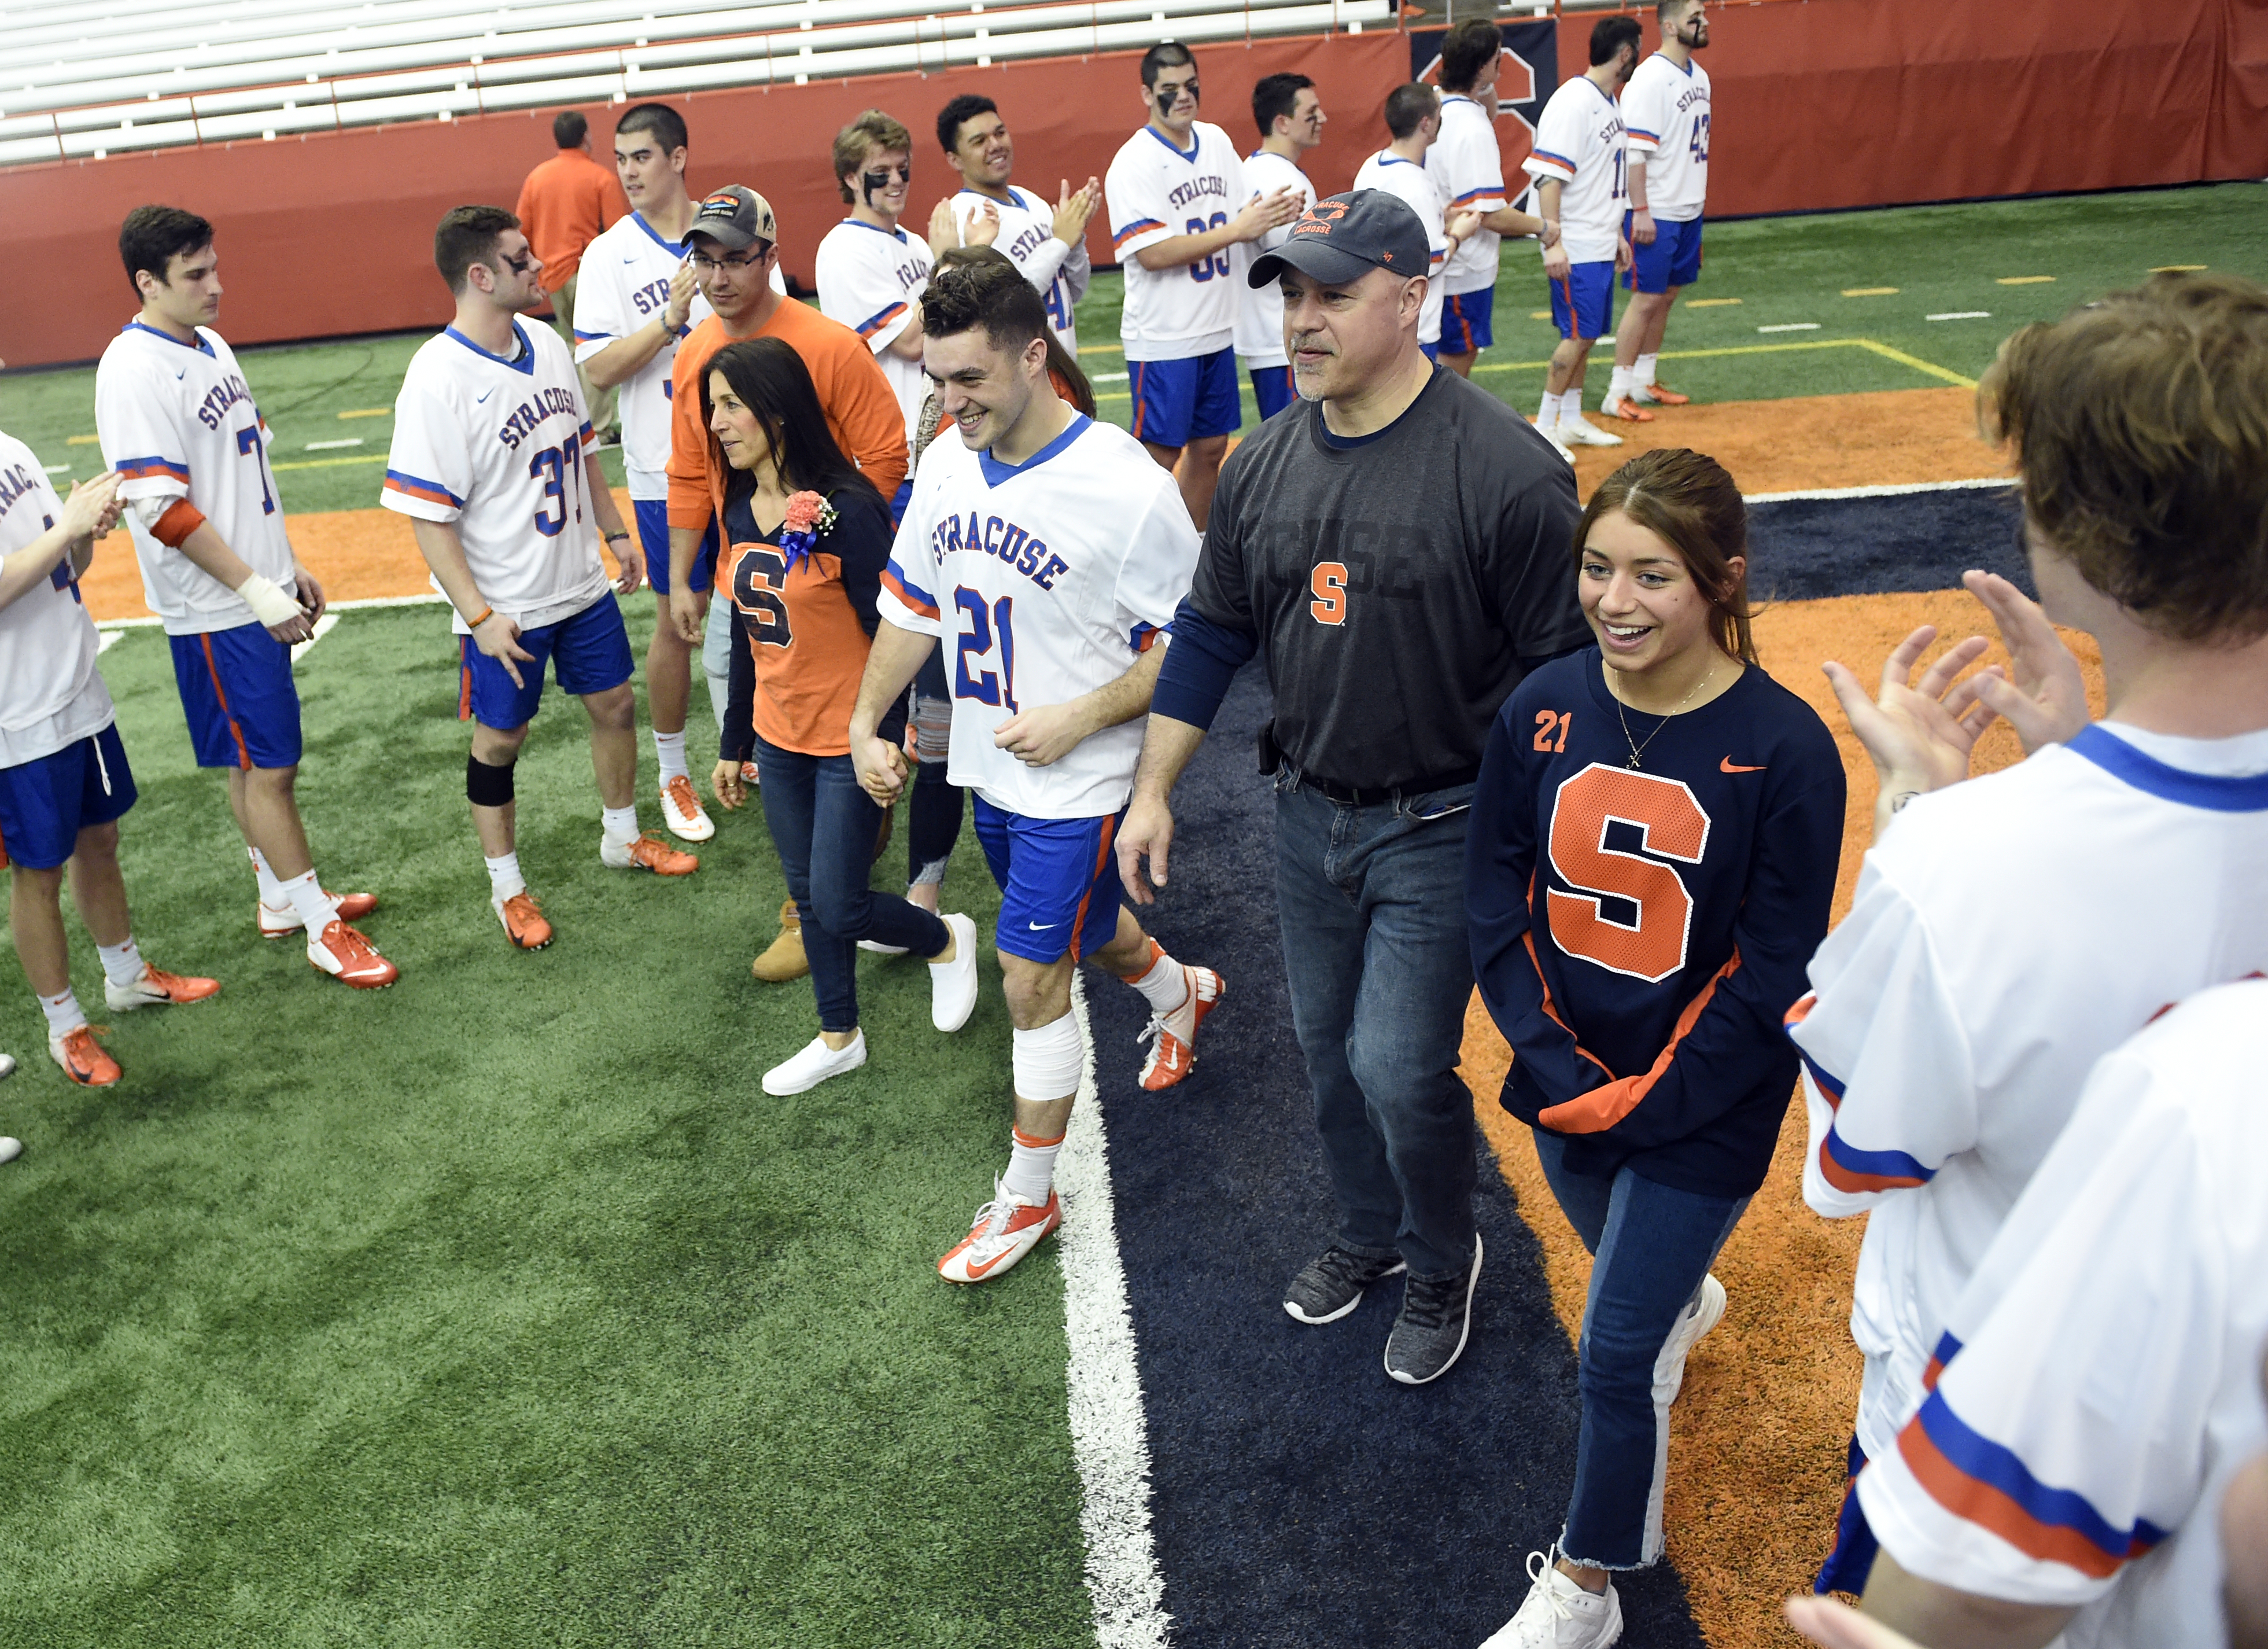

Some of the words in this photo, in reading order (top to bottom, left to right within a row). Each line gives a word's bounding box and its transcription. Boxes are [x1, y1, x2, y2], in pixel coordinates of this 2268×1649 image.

[236, 425, 275, 515] 7
[529, 432, 581, 537] 37
[932, 511, 1070, 591] SYRACUSE
[1311, 562, 1348, 625] S
[732, 549, 793, 649] S
[953, 583, 1019, 715] 21
[1533, 710, 1572, 753] 21
[1546, 762, 1711, 983] S
